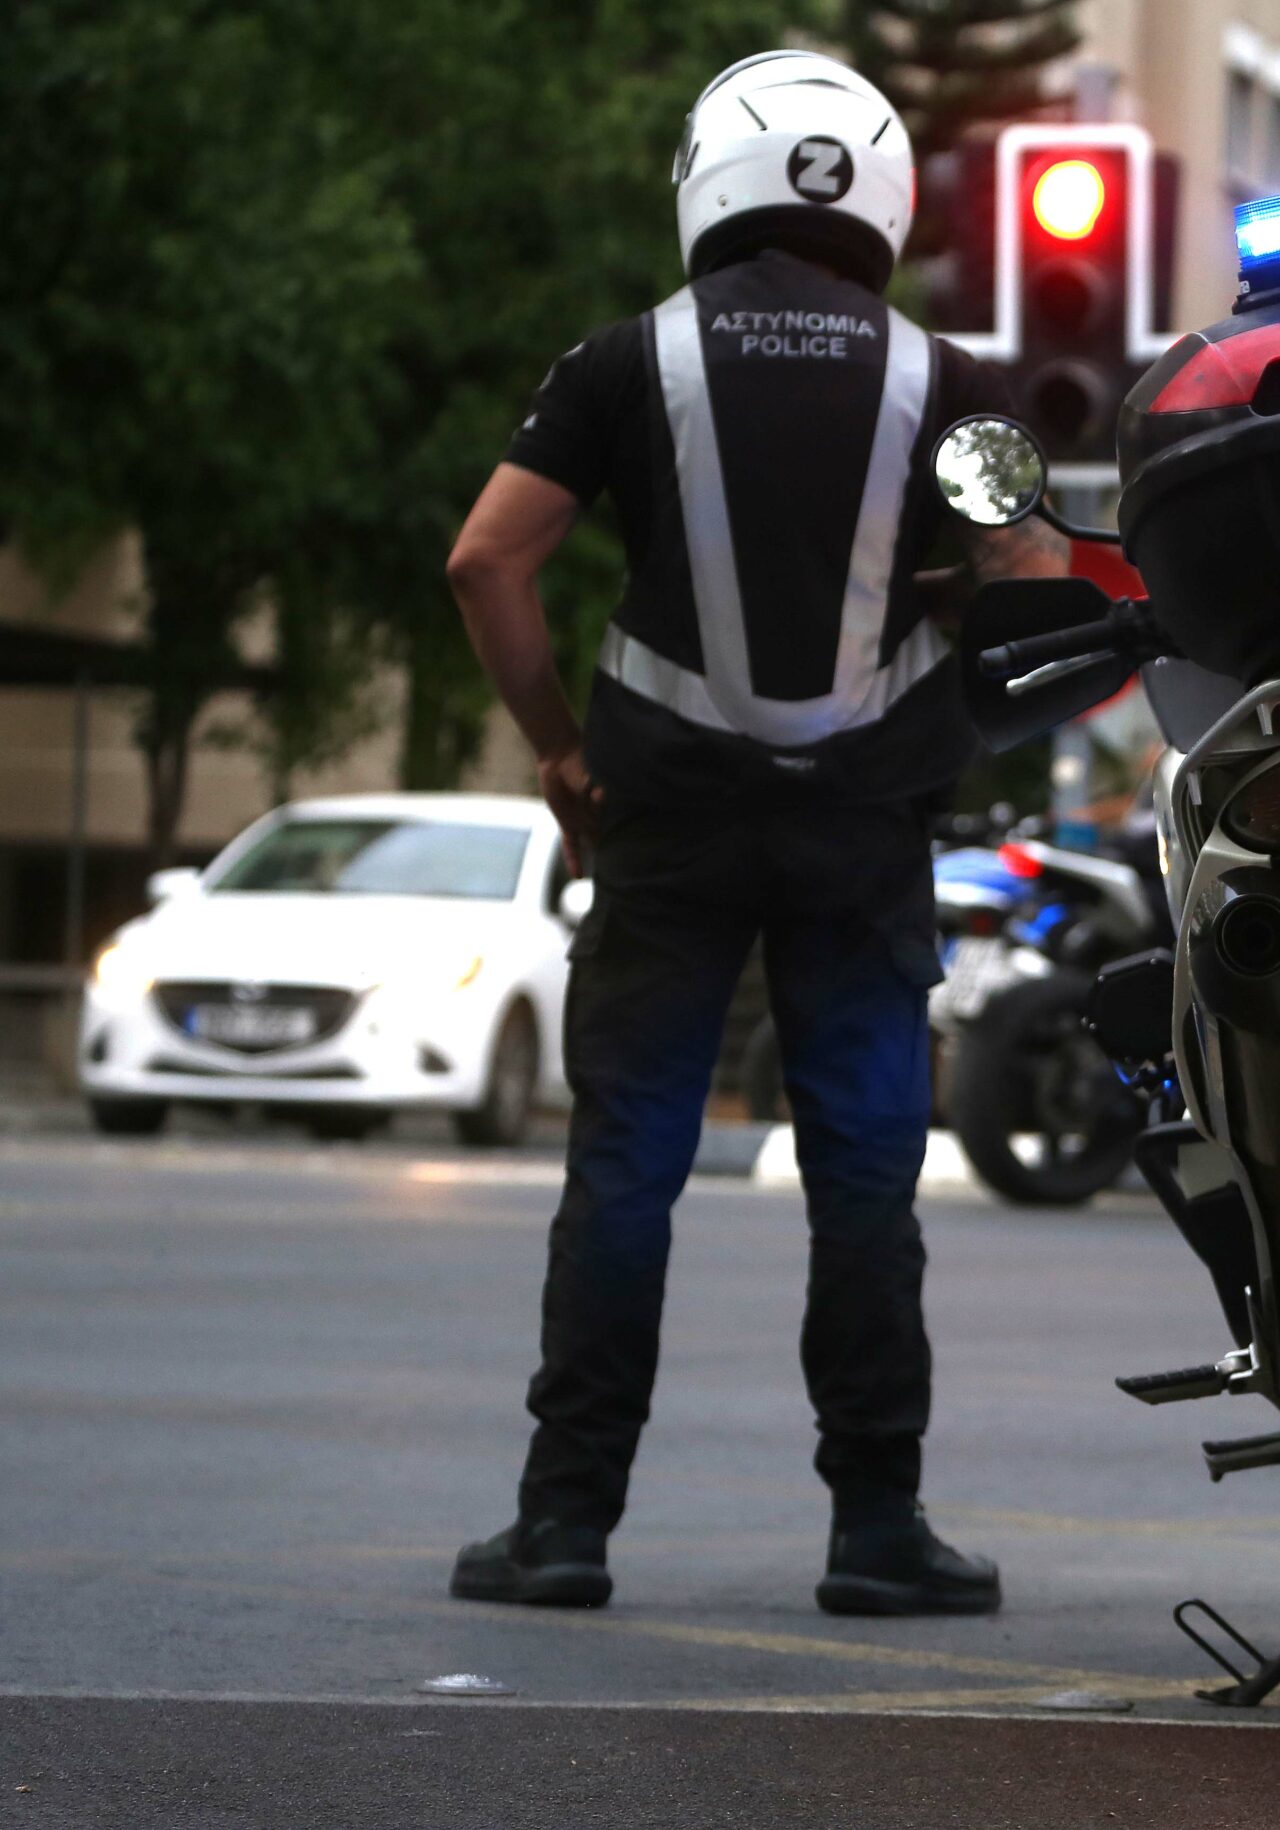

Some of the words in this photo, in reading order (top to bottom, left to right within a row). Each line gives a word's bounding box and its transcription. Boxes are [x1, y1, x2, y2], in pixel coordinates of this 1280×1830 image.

[796, 139, 842, 195] Z
[710, 310, 878, 340] ΑΣΤΥΝΟΜΙΑ
[742, 334, 847, 359] POLICE
